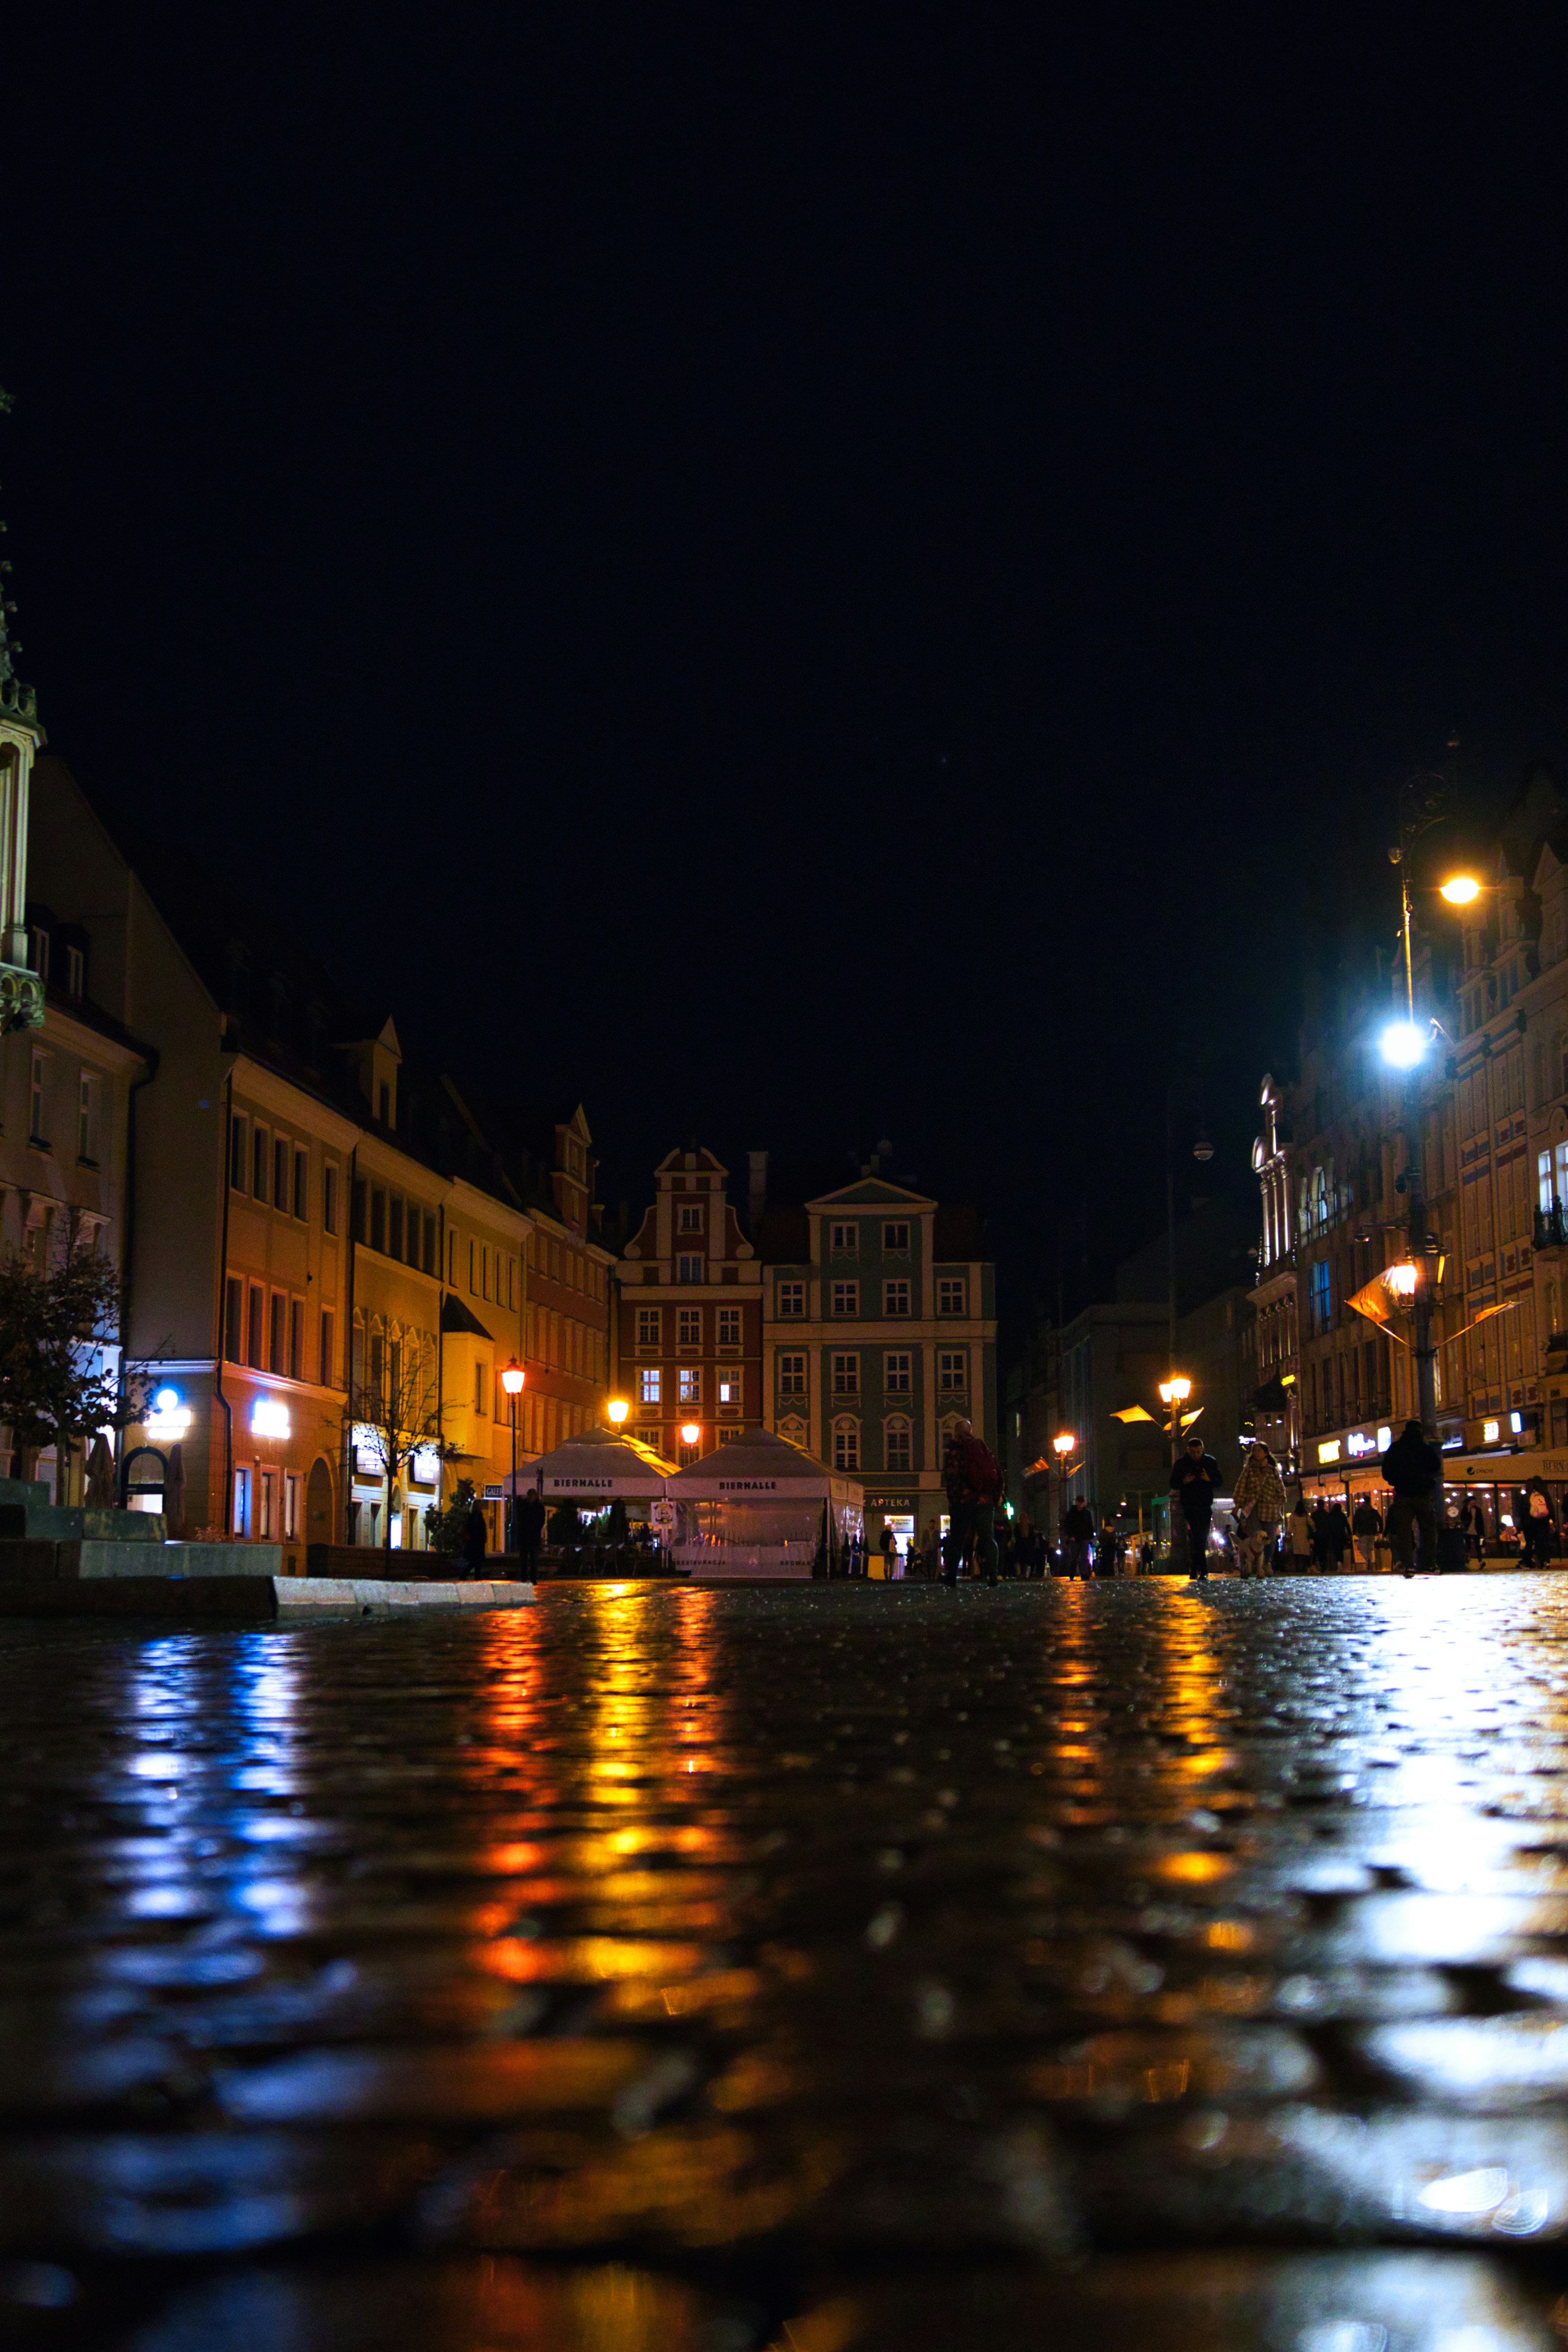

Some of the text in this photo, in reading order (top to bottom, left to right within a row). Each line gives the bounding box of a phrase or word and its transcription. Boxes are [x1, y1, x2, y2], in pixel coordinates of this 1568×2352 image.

[554, 1479, 613, 1487] BIERHALLE
[719, 1481, 776, 1490] BIERHALLE
[870, 1498, 910, 1507] APTEKA
